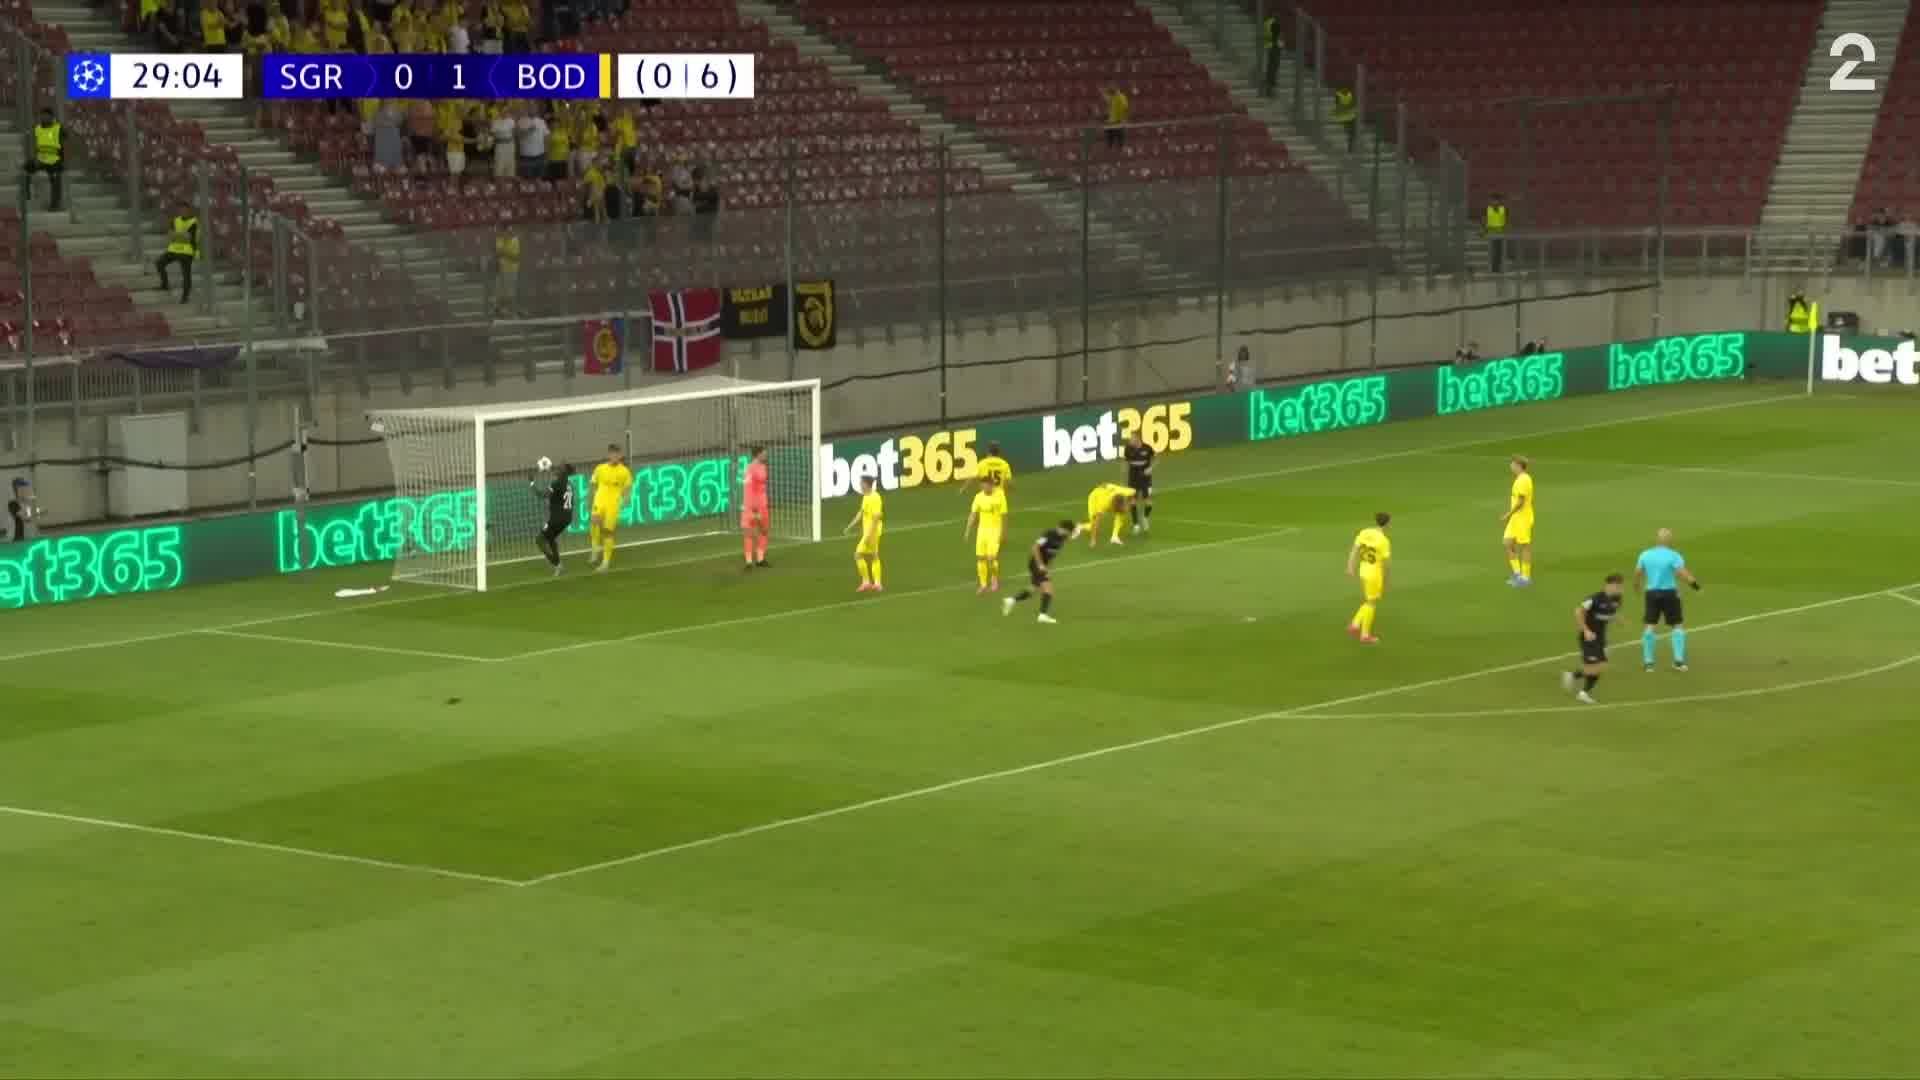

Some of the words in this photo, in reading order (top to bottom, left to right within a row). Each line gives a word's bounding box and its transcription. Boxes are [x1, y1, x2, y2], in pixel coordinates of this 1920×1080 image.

[1438, 353, 1563, 415] bet365
[1609, 333, 1744, 391] bet365
[1250, 376, 1386, 440] bet365
[820, 428, 978, 499] bet365
[279, 490, 478, 573] bet365
